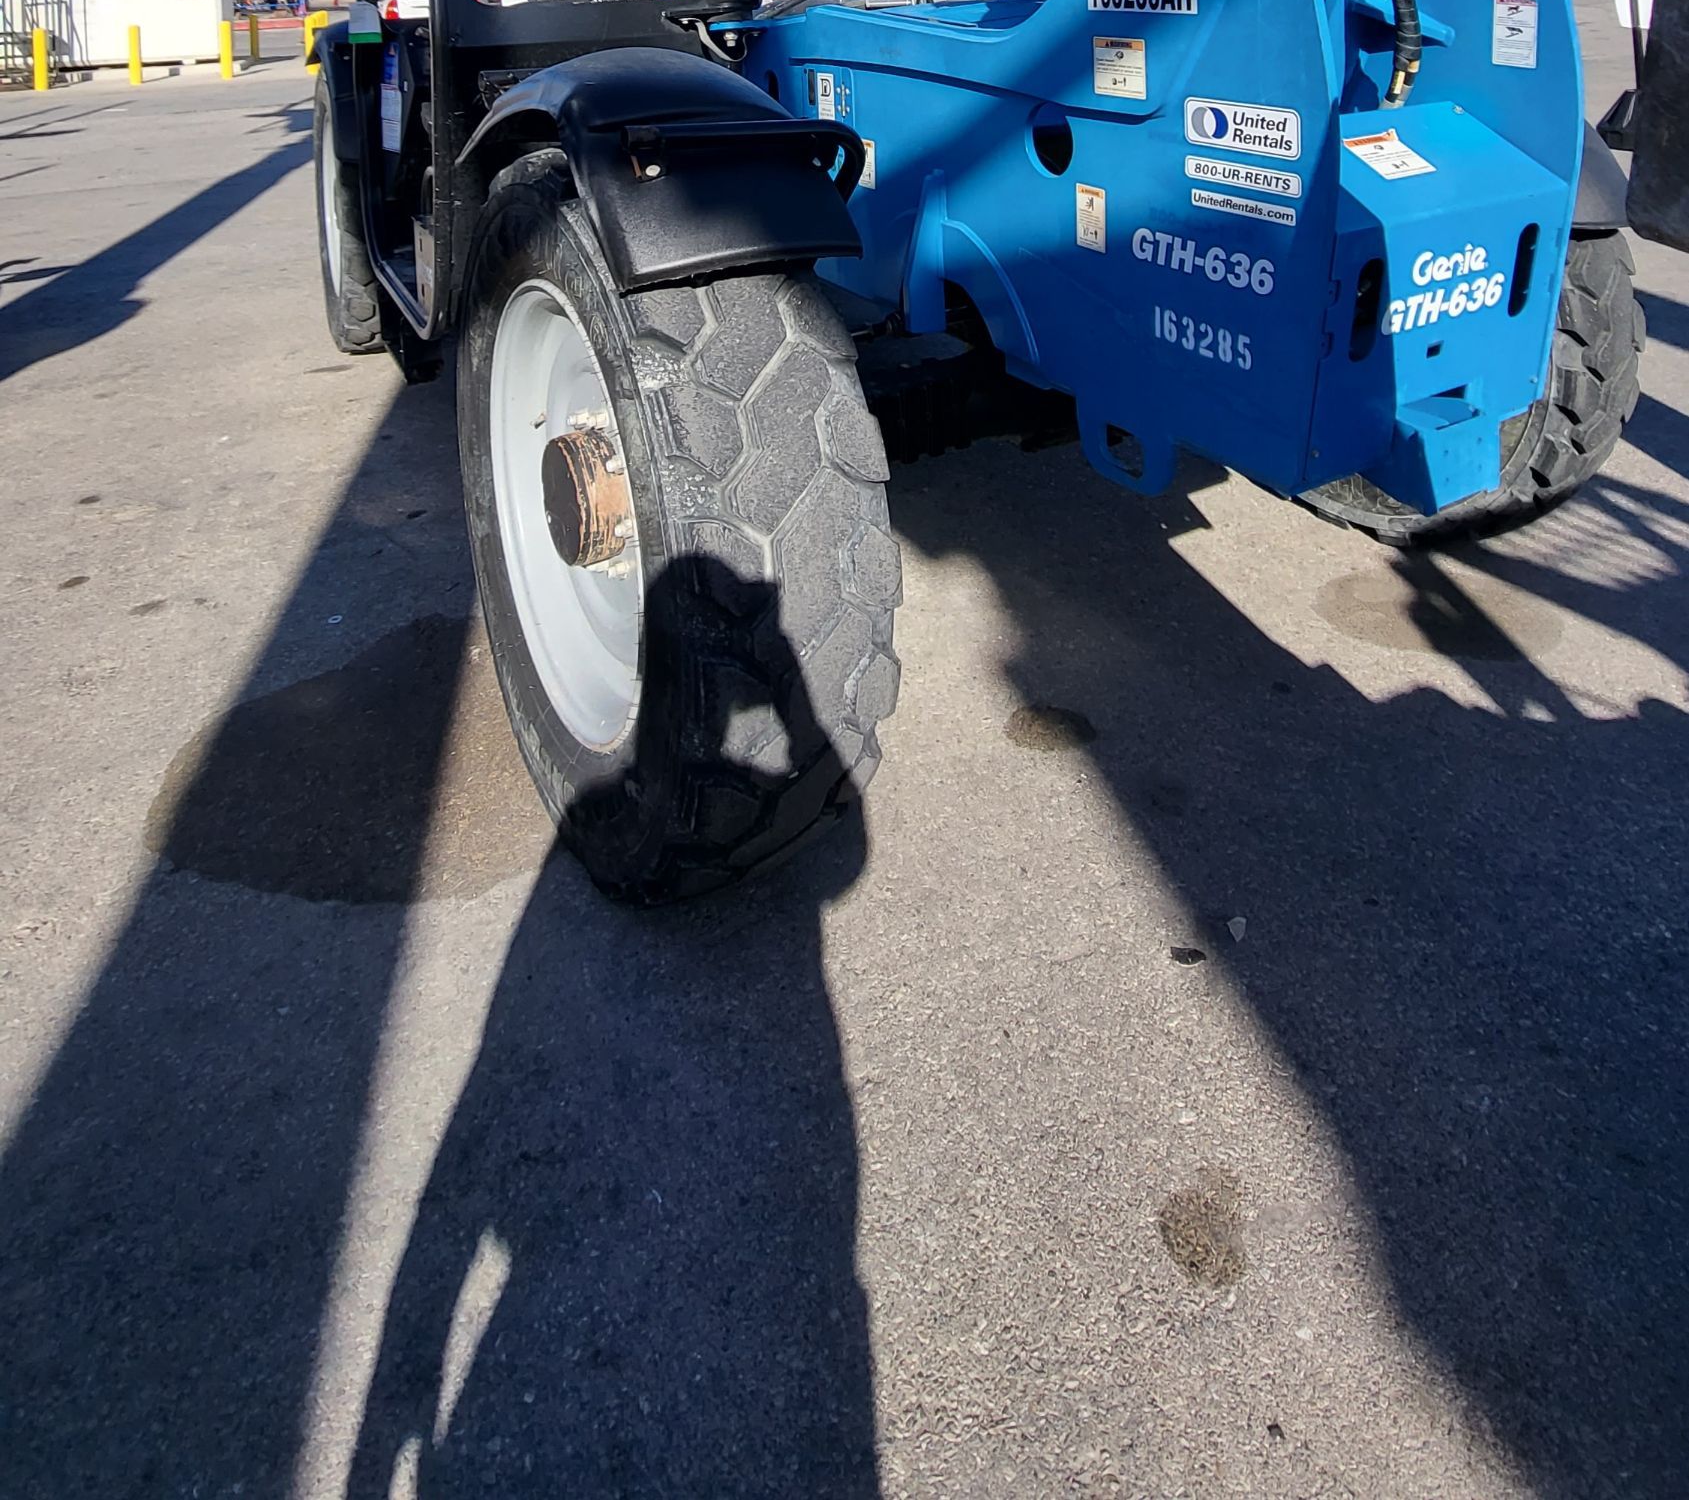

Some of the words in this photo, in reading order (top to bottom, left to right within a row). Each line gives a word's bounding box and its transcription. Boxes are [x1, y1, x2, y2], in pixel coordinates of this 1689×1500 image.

[1232, 110, 1288, 133] United
[1232, 128, 1293, 151] Rentals
[1194, 163, 1292, 191] 800-UR-RENTS
[1193, 192, 1294, 222] UnitedRentals.com
[1132, 228, 1275, 295] GTH-636
[1412, 243, 1488, 287] Genie
[1381, 272, 1506, 336] GTH-636
[1154, 305, 1252, 371] 163285
